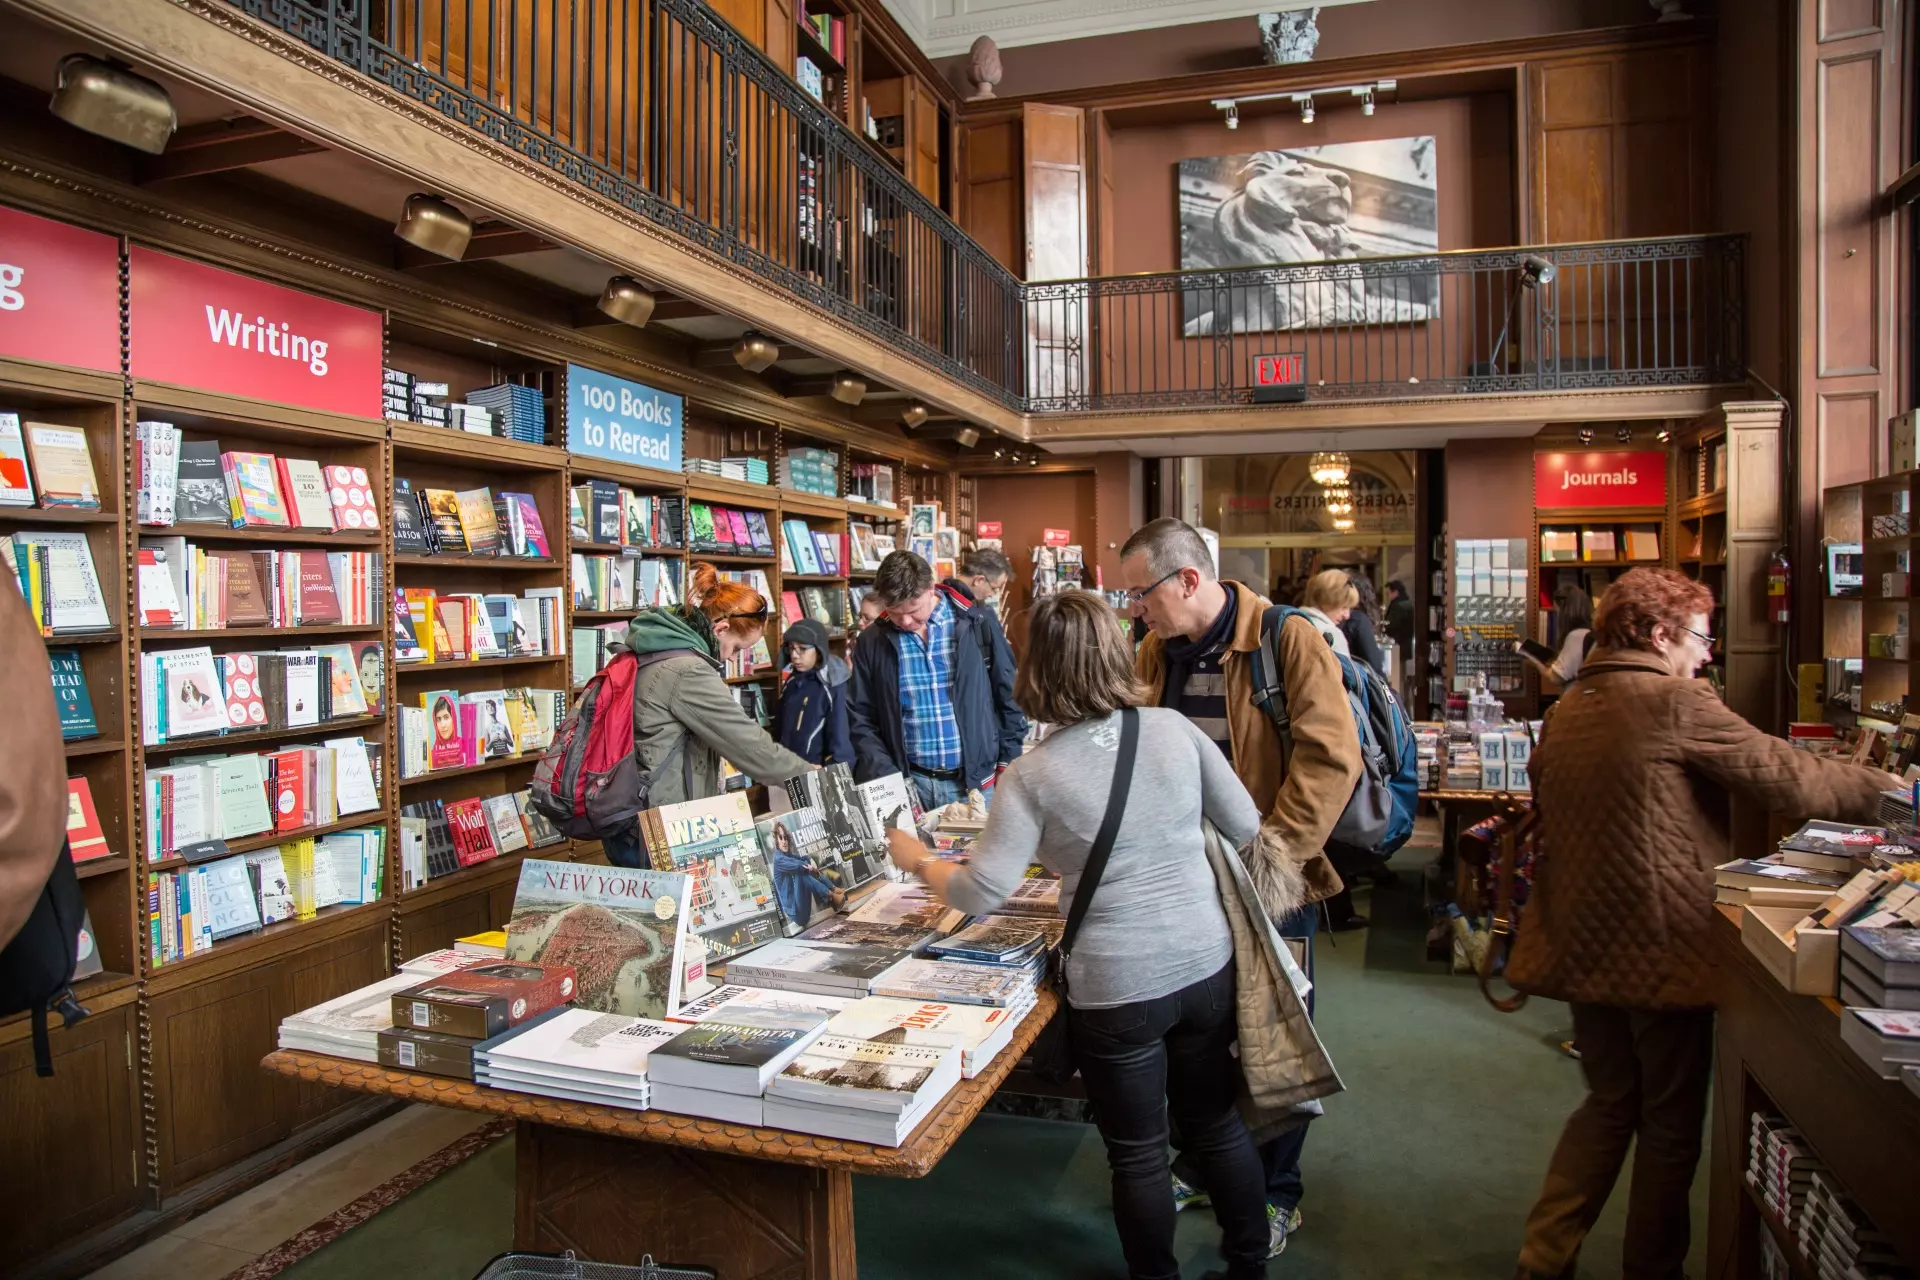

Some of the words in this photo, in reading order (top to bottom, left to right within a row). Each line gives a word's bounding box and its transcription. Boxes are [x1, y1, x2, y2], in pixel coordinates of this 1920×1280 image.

[205, 305, 328, 376] Writing
[395, 370, 408, 384] YORK
[1258, 356, 1302, 384] EXIT
[394, 384, 407, 398] YORK
[394, 398, 407, 411] YORK
[581, 384, 616, 412] 100
[620, 387, 672, 427] Books
[432, 406, 445, 420] YORK
[583, 417, 605, 447] to
[609, 421, 670, 461] Reread
[1561, 467, 1638, 490] Journals
[392, 529, 421, 540] LARSON
[173, 652, 208, 660] ELEMENTS
[180, 660, 200, 668] STYLE
[287, 656, 301, 666] WAR
[305, 655, 317, 665] ART
[50, 659, 59, 672] O
[62, 660, 81, 671] WE
[51, 674, 81, 687] READ
[62, 688, 78, 701] ON
[869, 783, 885, 794] Banksy
[456, 809, 485, 831] Wolf
[799, 806, 822, 827] JOHN
[668, 813, 721, 847] WES
[792, 822, 827, 848] LENNON
[462, 830, 492, 854] Hall
[731, 818, 754, 881] ANDERSON
[256, 855, 280, 864] bryson
[543, 871, 592, 892] NEW
[598, 876, 655, 899] YORK
[698, 934, 737, 956] LLECTION
[678, 1002, 709, 1018] THE
[899, 1003, 949, 1029] ORKS
[618, 1030, 653, 1038] GRID
[626, 1026, 676, 1037] GREAT
[636, 1023, 663, 1031] THE
[694, 1022, 797, 1040] MANNAHATTA
[816, 1041, 849, 1050] NEW
[856, 1047, 896, 1056] YORK
[905, 1051, 942, 1060] CITY
